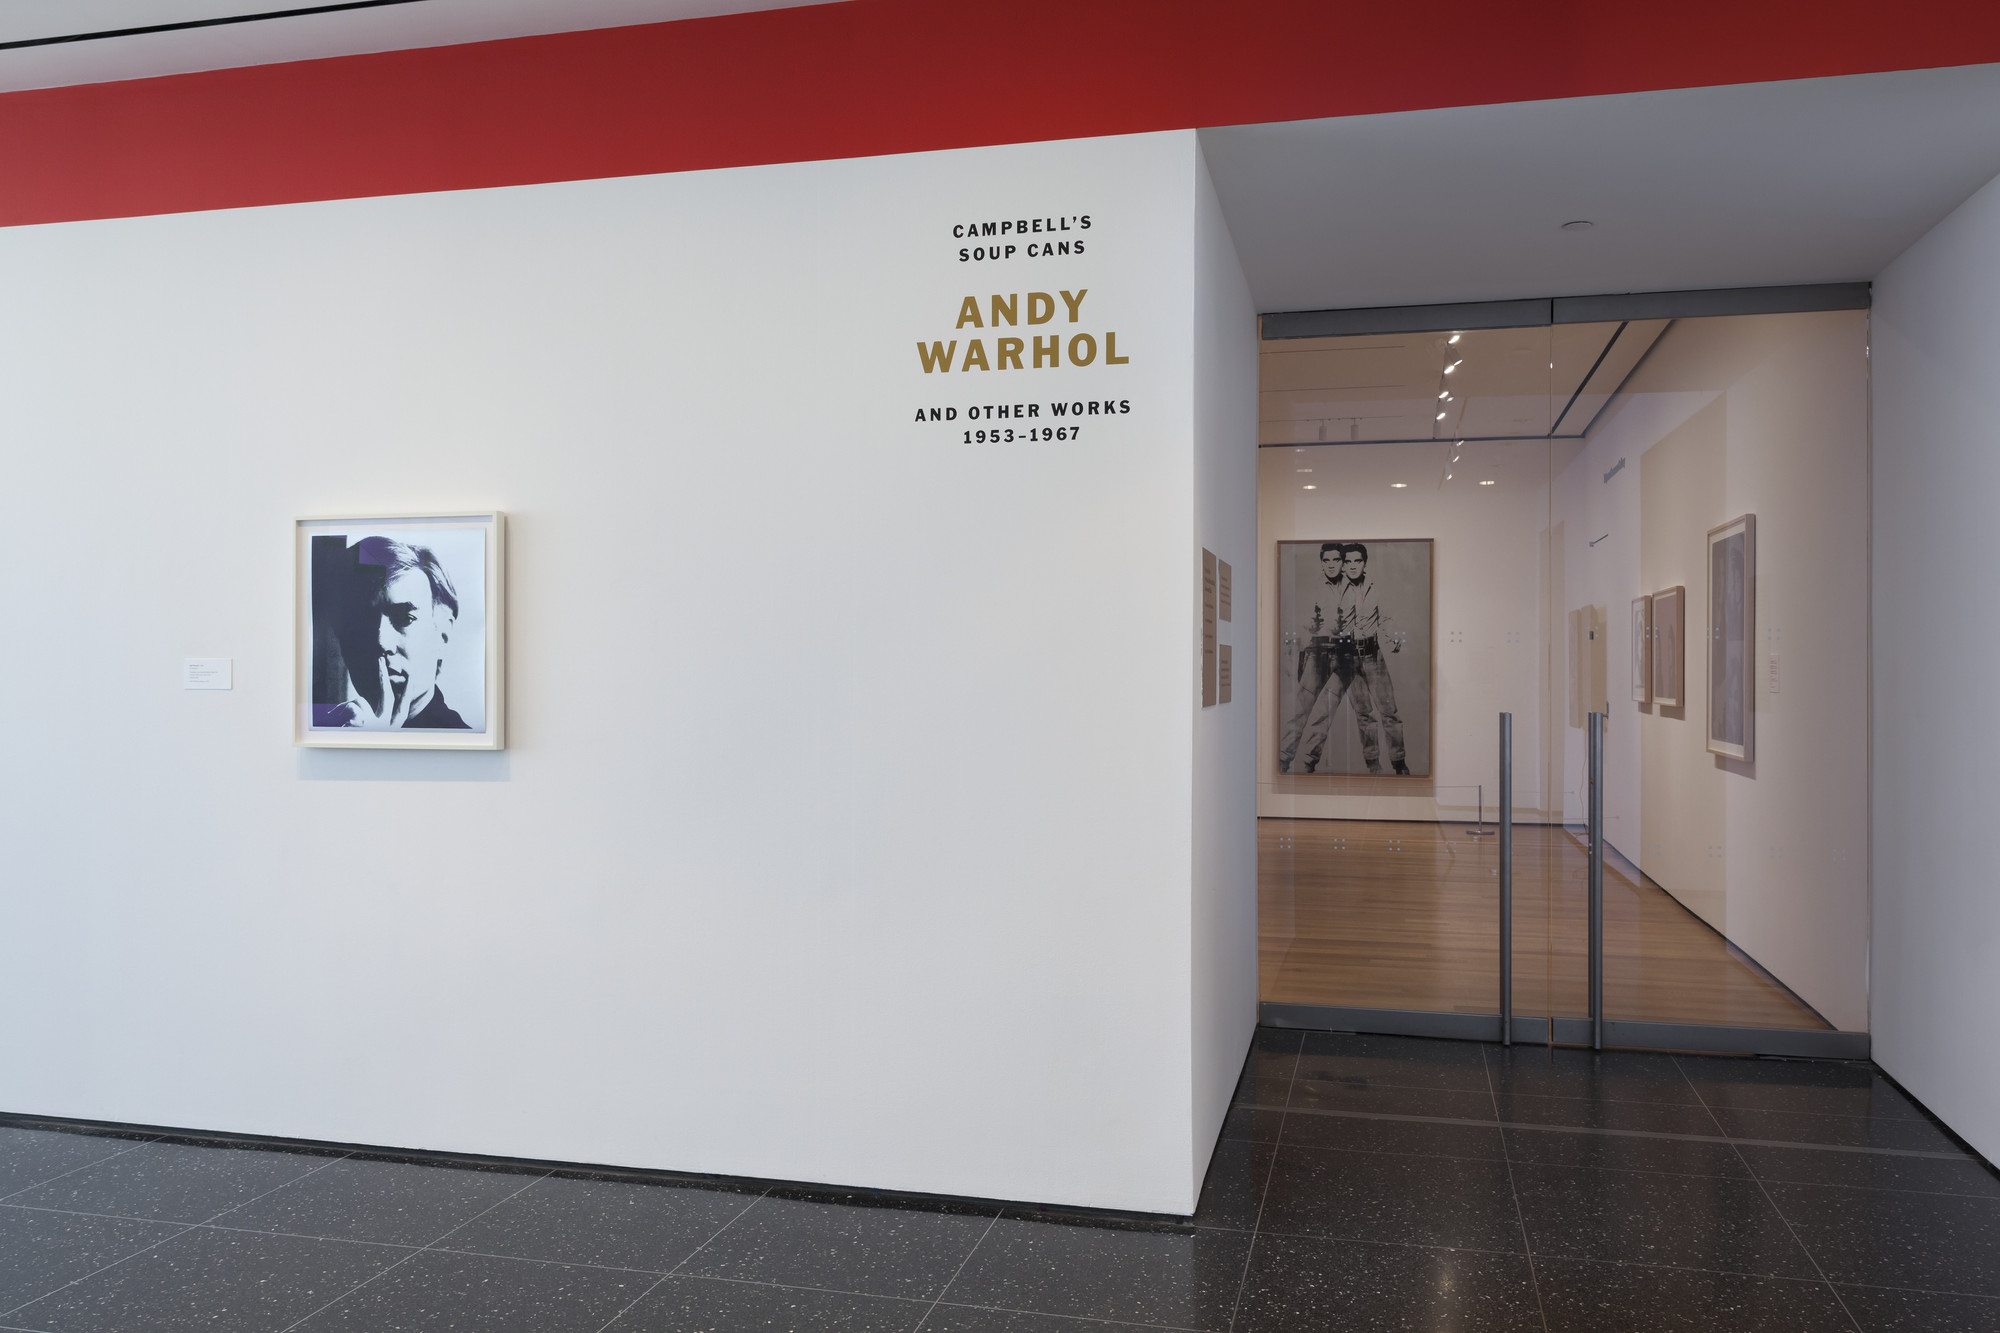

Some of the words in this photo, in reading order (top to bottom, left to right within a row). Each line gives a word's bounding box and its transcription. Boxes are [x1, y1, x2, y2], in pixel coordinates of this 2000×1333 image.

[952, 215, 1092, 239] CAMPBELL’S
[958, 245, 1017, 263] SOUP
[1027, 240, 1085, 258] CANS
[955, 289, 1088, 330] ANDY
[916, 331, 1130, 374] WARHOL
[914, 407, 958, 422] AND
[968, 403, 1040, 420] OTHER
[1050, 399, 1131, 417] WORKS
[963, 426, 1080, 445] 1953–1967
